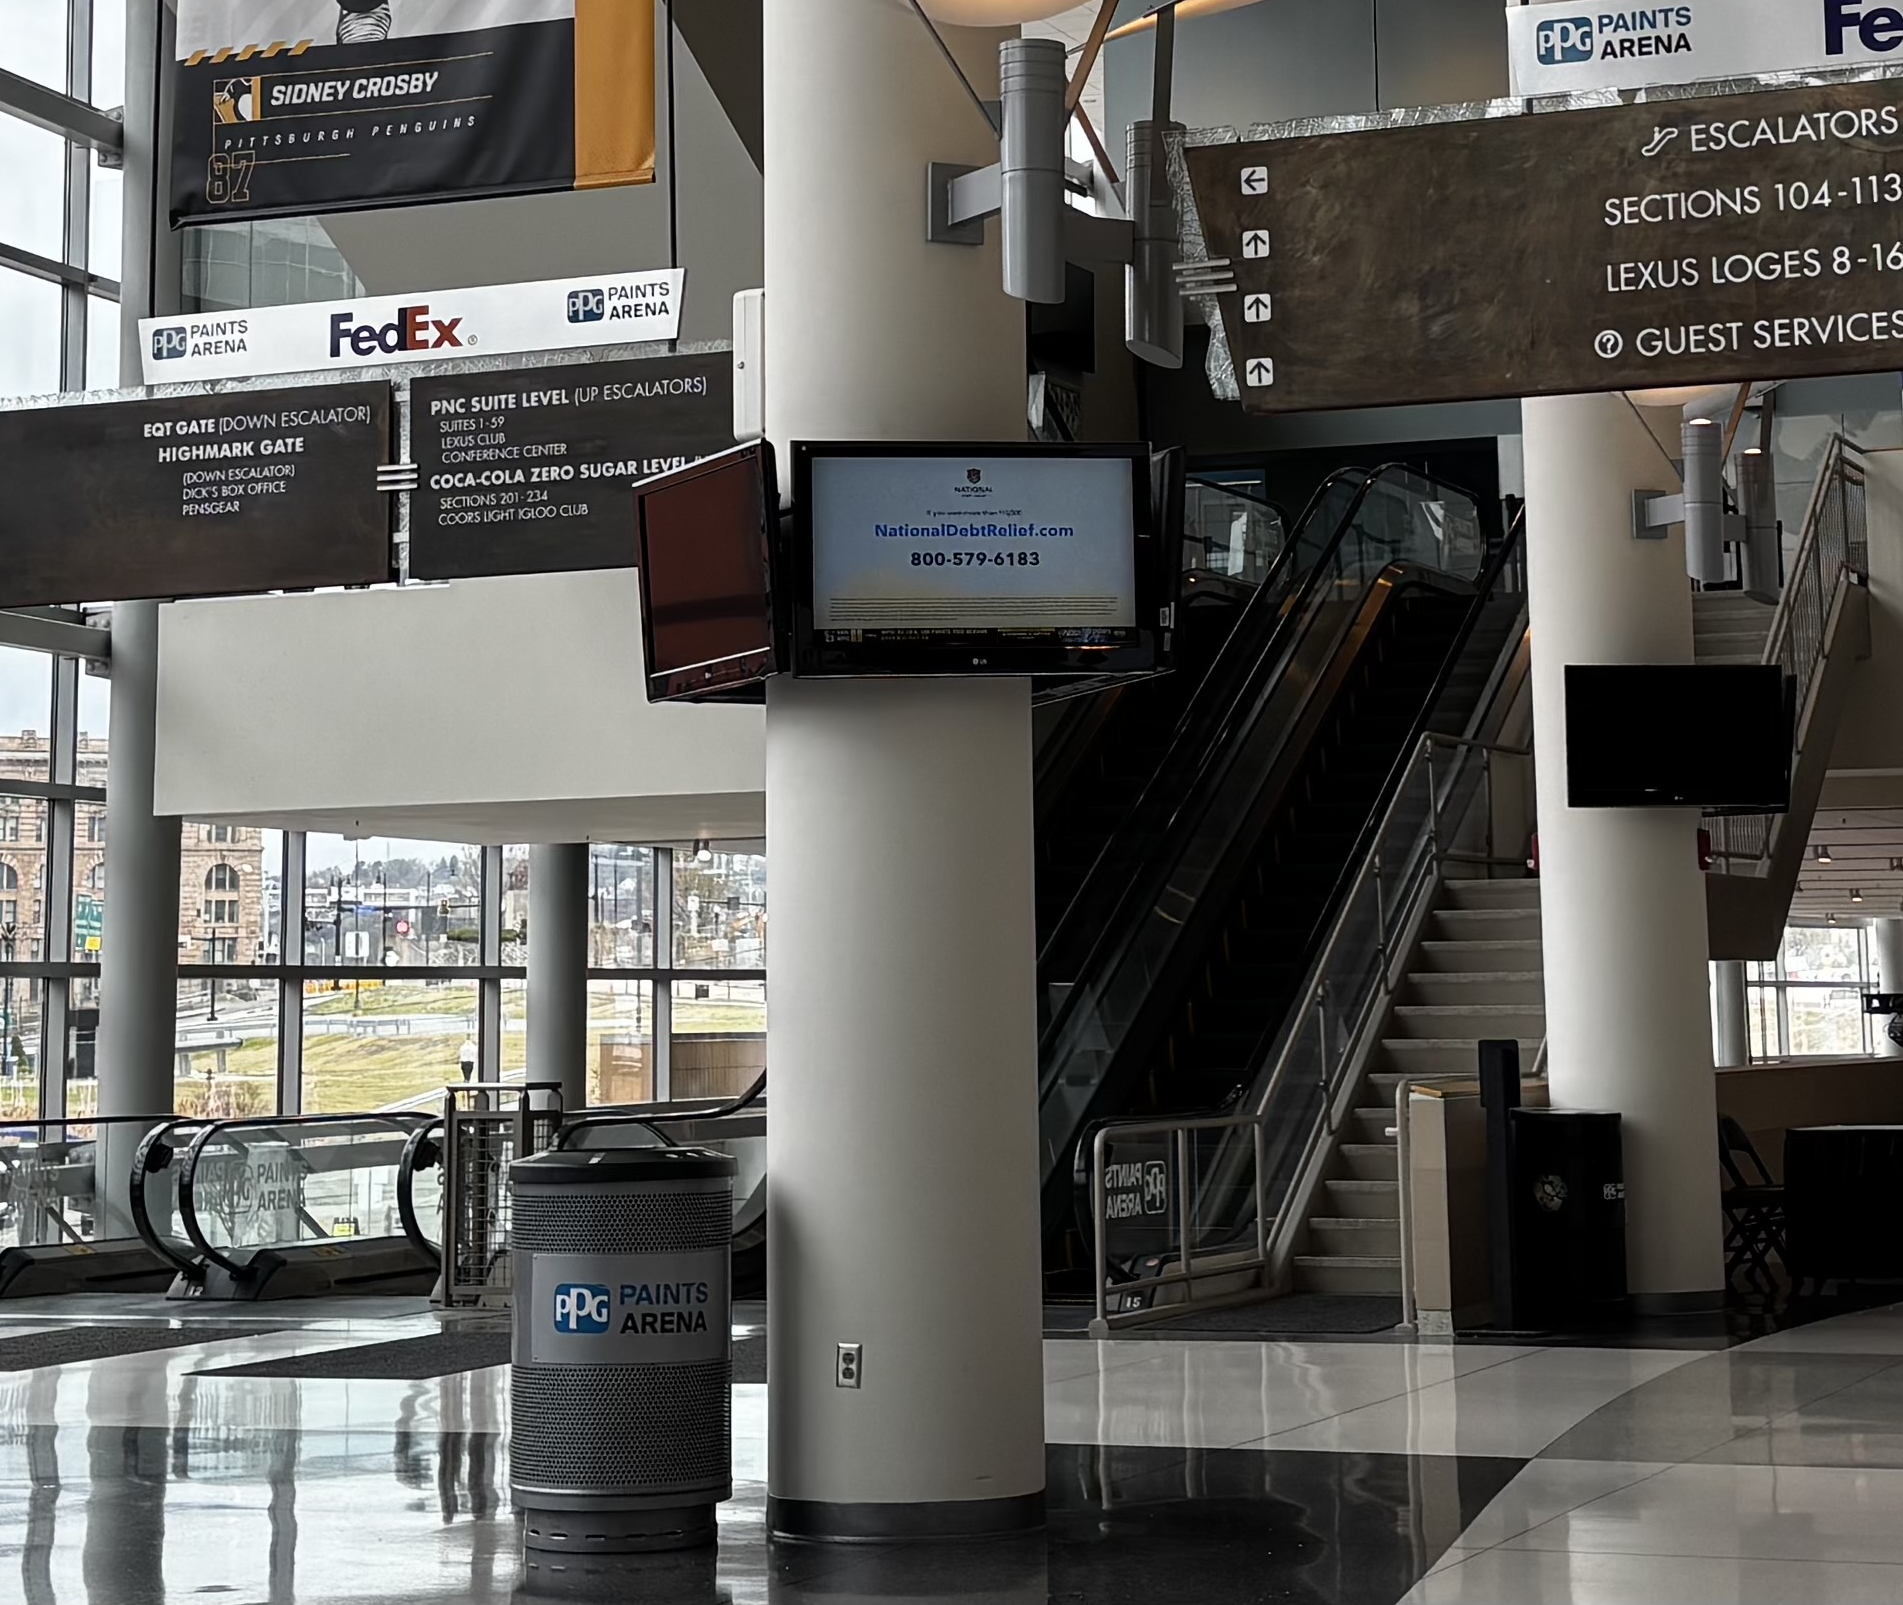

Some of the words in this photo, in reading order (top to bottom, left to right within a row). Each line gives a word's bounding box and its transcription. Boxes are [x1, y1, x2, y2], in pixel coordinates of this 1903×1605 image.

[1538, 20, 1593, 63] PPG
[1598, 6, 1692, 35] PAINTS
[1600, 32, 1692, 61] ARENA
[271, 80, 350, 107] SIDNEY
[353, 70, 439, 100] CROSBY
[223, 126, 358, 153] PITTSBURGH
[372, 114, 478, 139] PENGUINS
[1691, 105, 1900, 154] ESCALATORS
[205, 150, 256, 205] 87
[1605, 184, 1761, 227] SECTIONS
[1773, 173, 1903, 214] 104-113
[1606, 257, 1700, 293] LEXUS
[1711, 247, 1820, 286] LOGES
[567, 289, 604, 322] PPG
[607, 281, 670, 301] PAINTS
[609, 300, 670, 321] ARENA
[154, 328, 187, 358] PPG
[190, 320, 248, 339] PAINTS
[330, 305, 463, 358] FedEx
[1636, 320, 1741, 359] GUEST
[191, 337, 248, 358] ARENA
[430, 397, 466, 416] PNC
[470, 393, 517, 413] SUITE
[521, 389, 570, 409] LEVEL
[574, 386, 599, 407] (UP
[603, 376, 708, 401] ESCALATORS)
[143, 422, 173, 439] EQT
[176, 418, 216, 436] GATE
[218, 413, 277, 436] (DOWN
[281, 405, 372, 428] ESCALATOR)
[439, 419, 476, 433] SUITES
[479, 415, 505, 430] 1-59
[158, 440, 255, 463] HIGHMARK
[259, 436, 305, 455] GATE
[441, 435, 475, 449] LEXUS
[478, 432, 506, 446] CLUB
[441, 446, 521, 464] CONFERENCE
[523, 443, 568, 458] CENTER
[182, 468, 226, 487] (DOWN
[228, 464, 296, 482] ESCALATOR)
[429, 467, 526, 490] COCA-COLA
[530, 464, 575, 483] ZERO
[579, 460, 638, 479] SUGAR
[182, 486, 218, 501] DICK'S
[221, 483, 246, 497] BOX
[247, 480, 287, 494] OFFICE
[439, 492, 497, 509] SECTIONS
[500, 489, 549, 505] 201-234
[182, 501, 240, 516] PENSGEAR
[438, 510, 481, 526] COORS
[483, 508, 516, 524] LIGHT
[518, 505, 557, 520] IGLOO
[559, 503, 589, 517] CLUB
[874, 523, 1075, 539] NationalDebtRelief.com
[910, 551, 1041, 567] 800-579-6183
[555, 1285, 609, 1333] PPG
[619, 1281, 709, 1308] PAINTS
[620, 1308, 708, 1336] ARENA
